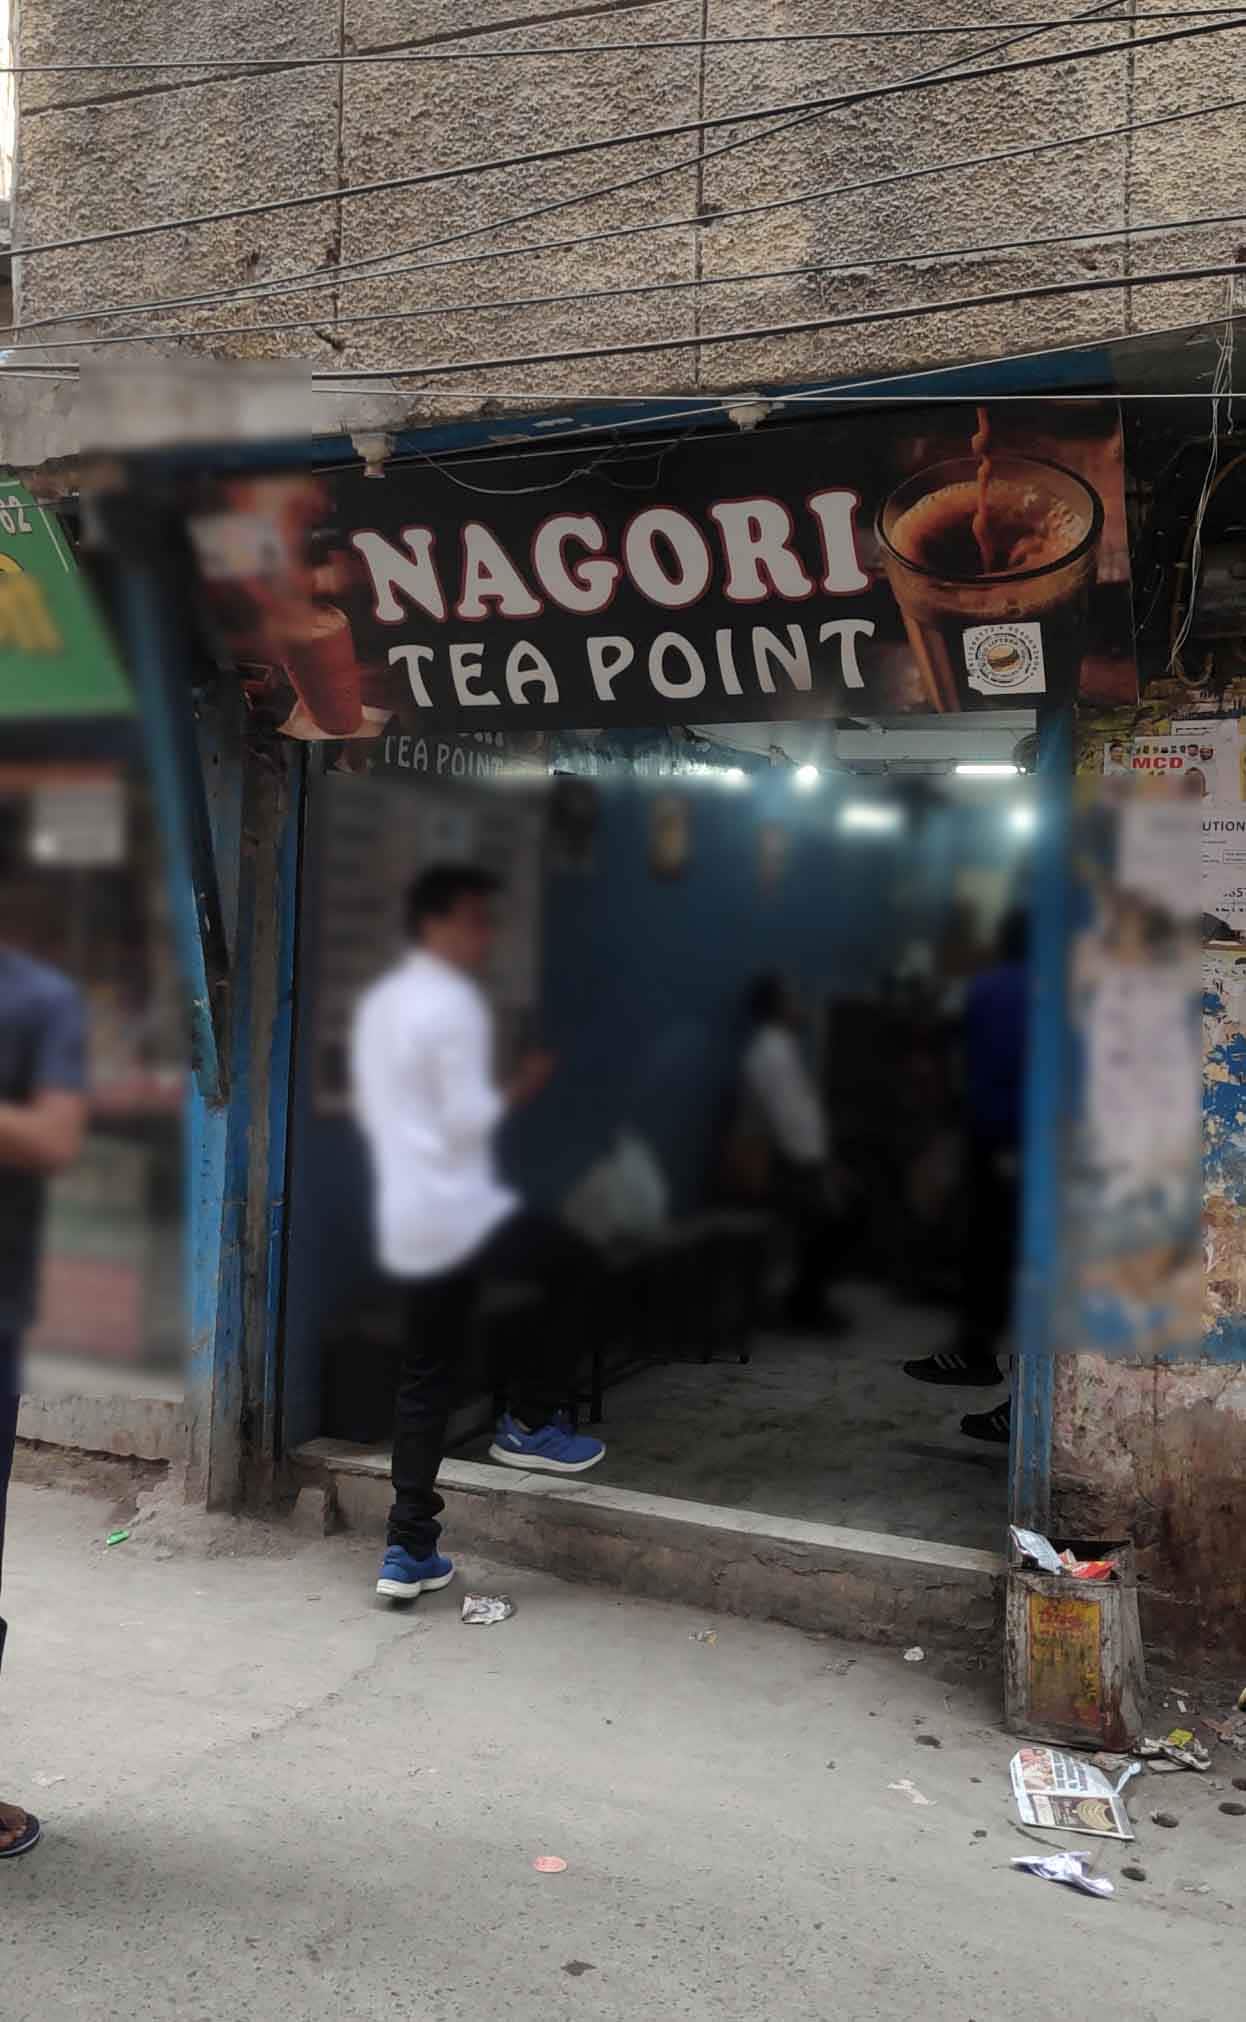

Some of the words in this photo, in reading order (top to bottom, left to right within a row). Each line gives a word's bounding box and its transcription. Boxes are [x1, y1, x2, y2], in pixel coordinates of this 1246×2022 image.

[351, 490, 872, 624] NAGORI
[388, 641, 561, 707] TEA
[586, 619, 876, 702] POINT
[1132, 756, 1184, 769] MCD
[1202, 820, 1246, 832] UTION
